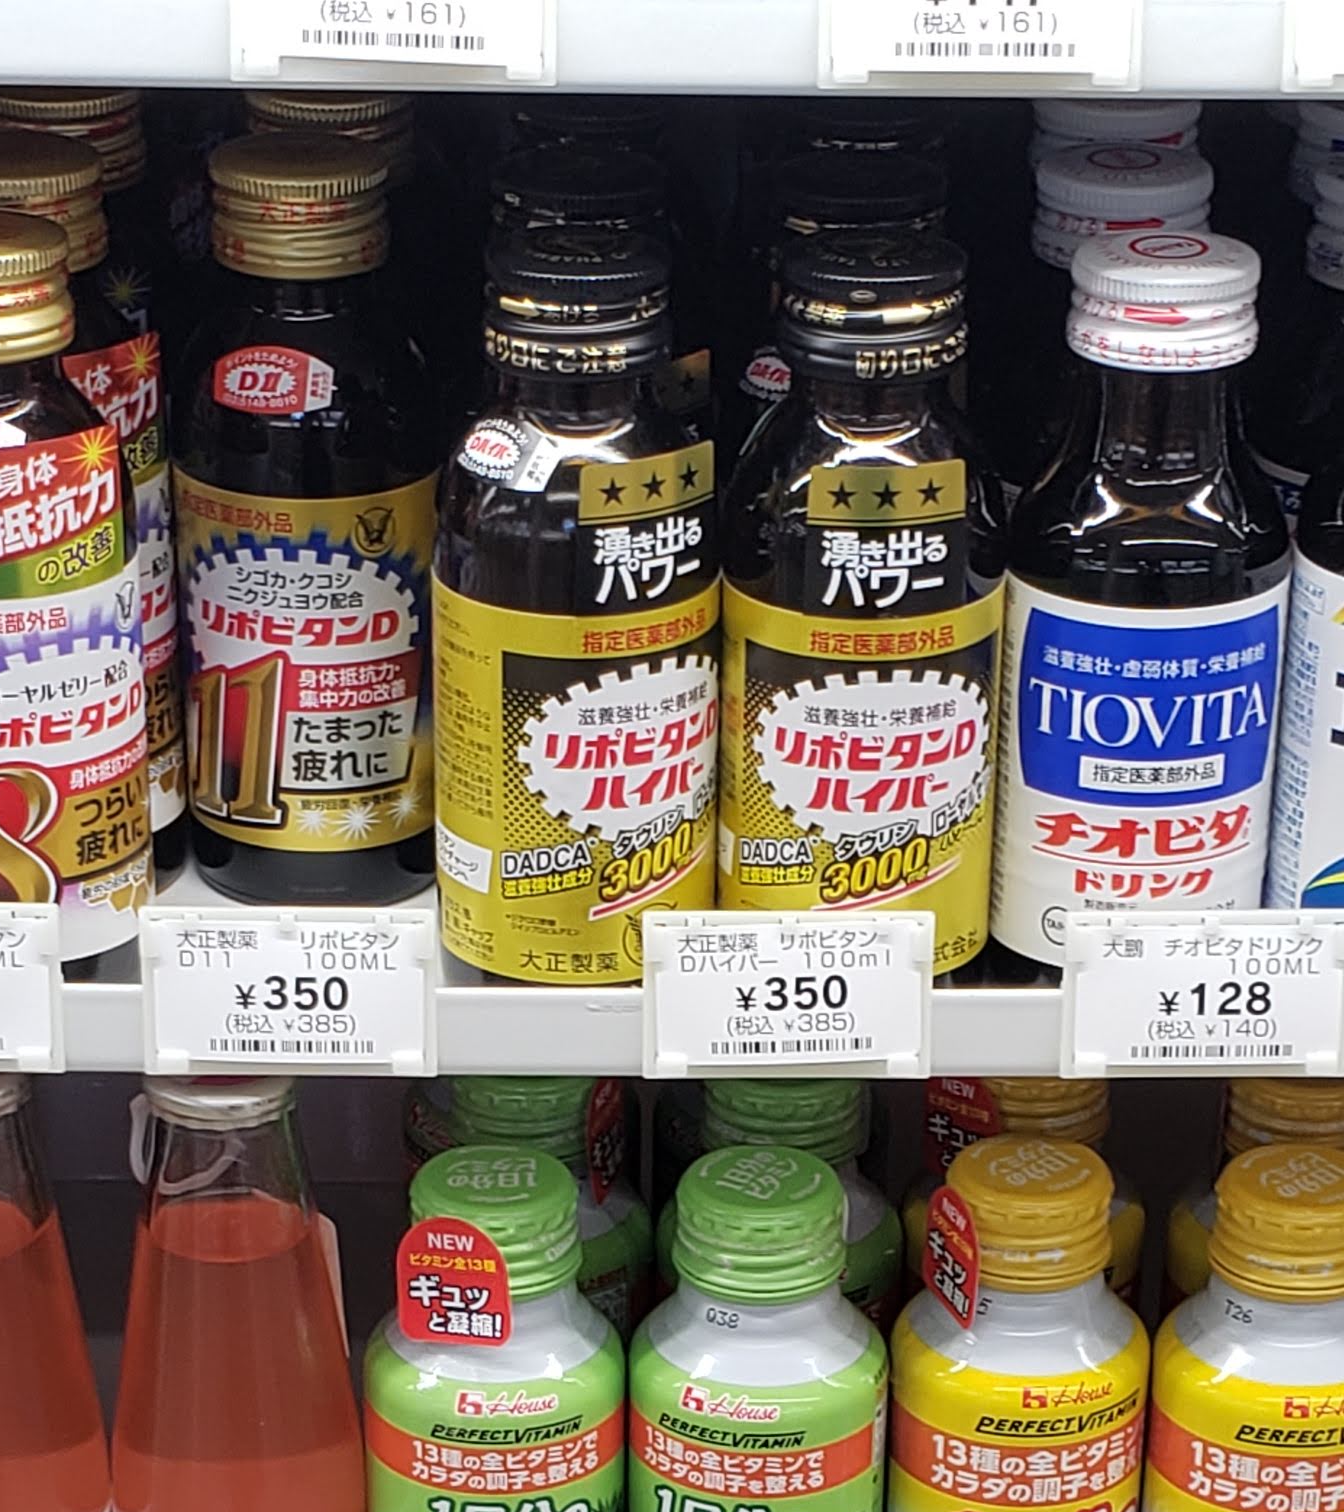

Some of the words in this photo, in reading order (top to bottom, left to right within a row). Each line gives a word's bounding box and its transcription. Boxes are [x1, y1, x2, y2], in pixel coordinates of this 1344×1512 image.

[979, 12, 1058, 34] ¥161)
[593, 515, 702, 565] 湧き出る
[822, 530, 947, 569] 湧き出る
[823, 565, 945, 608] パワー
[200, 608, 399, 648] リポビタンD
[809, 626, 955, 655] 指定医薬部外品
[294, 708, 402, 745] たまった
[1030, 674, 1267, 747] TIOVITA
[774, 718, 977, 770] リポビタンD
[293, 747, 388, 783] 疲れに
[809, 776, 947, 814] ハイパー
[1033, 804, 1250, 858] チオビタ
[822, 835, 930, 904] 3000
[1075, 867, 1213, 897] ドリンク
[177, 930, 257, 950] 大正製薬
[301, 932, 399, 951] リポビタン
[180, 951, 232, 969] D11
[304, 951, 397, 971] 100ML
[1229, 956, 1321, 975] 100ML
[235, 976, 350, 1011] ¥350
[736, 976, 848, 1011] ¥350
[1159, 982, 1272, 1015] ¥128
[284, 1014, 356, 1035] ¥385)
[1206, 1018, 1276, 1039] ¥140)
[428, 1232, 475, 1252] NEW
[409, 1278, 489, 1312] ギュッ
[414, 1432, 596, 1476] 13種の全ビタミンで
